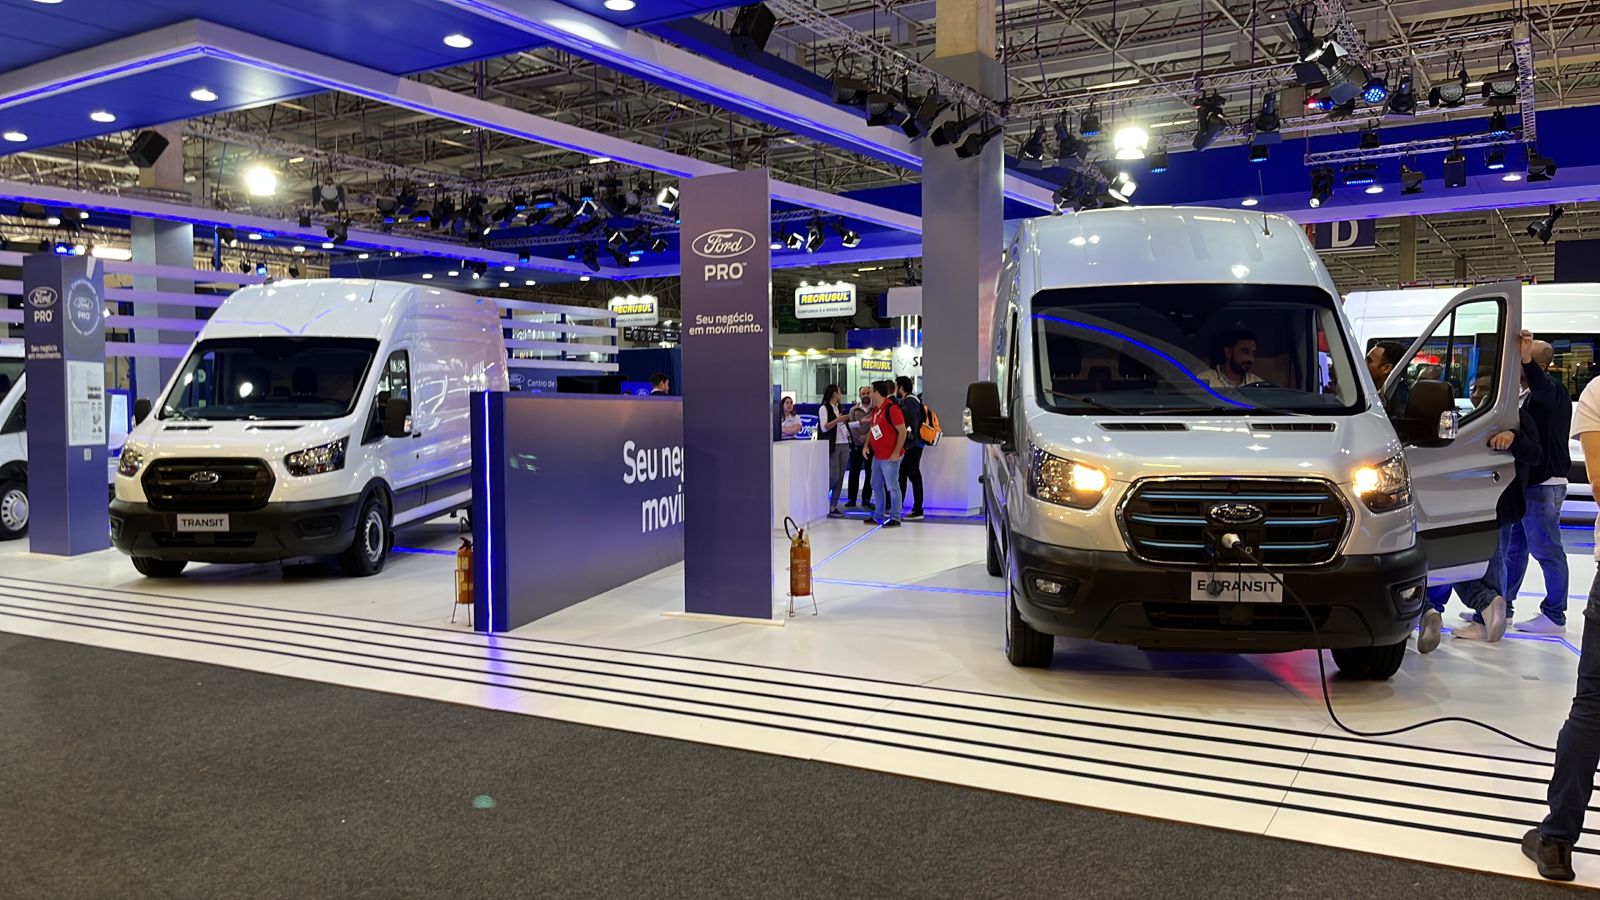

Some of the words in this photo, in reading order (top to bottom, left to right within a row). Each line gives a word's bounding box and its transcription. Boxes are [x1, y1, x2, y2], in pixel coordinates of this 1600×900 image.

[1332, 219, 1359, 247] D
[704, 233, 744, 254] Ford
[704, 262, 744, 281] PRO
[33, 288, 52, 304] Ford
[801, 292, 850, 304] RECRUSUL
[612, 303, 653, 314] RECRUSUL
[33, 310, 53, 322] PRO
[696, 314, 714, 325] Seu
[715, 312, 754, 325] negócio
[689, 326, 704, 336] em
[705, 323, 764, 335] movimento.
[863, 360, 891, 370] RECRUSUL
[527, 378, 547, 388] Centro
[547, 378, 556, 388] de
[623, 440, 658, 484] Seu
[642, 484, 685, 533] movi
[181, 518, 225, 527] TRANSIT
[1197, 580, 1278, 593] ERANSIT
